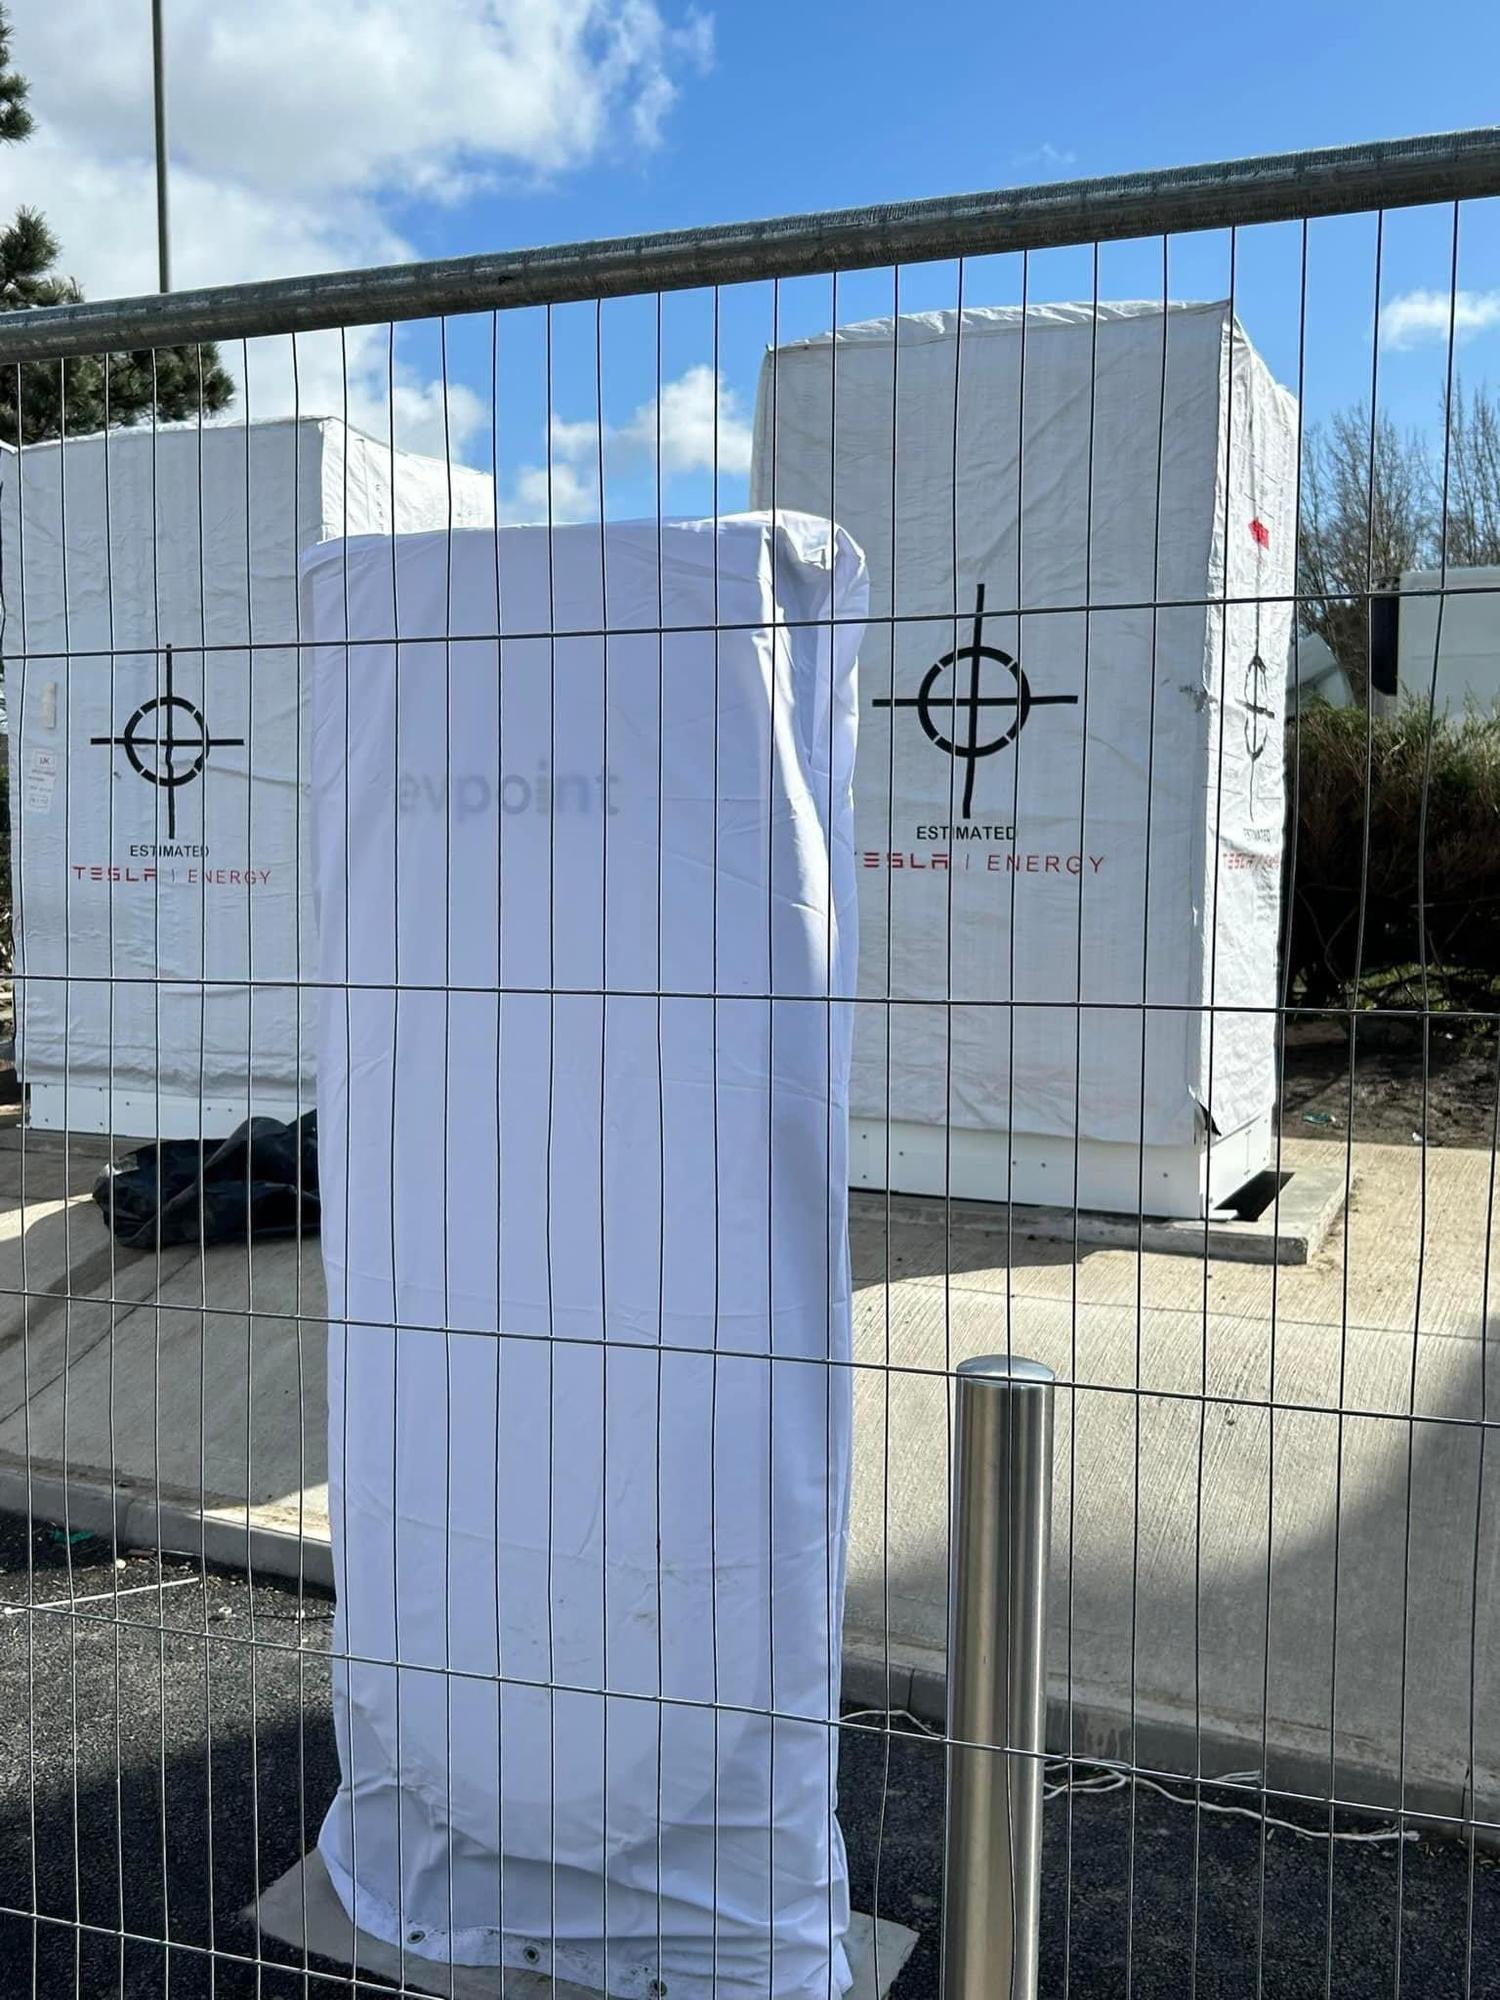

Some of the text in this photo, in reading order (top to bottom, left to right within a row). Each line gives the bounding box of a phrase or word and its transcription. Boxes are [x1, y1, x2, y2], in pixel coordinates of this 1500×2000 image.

[395, 758, 622, 823] evpoint
[129, 845, 210, 857] ESTIMATED
[853, 852, 1105, 875] ESLA ENERGY
[72, 866, 272, 886] TESLA ENERGY
